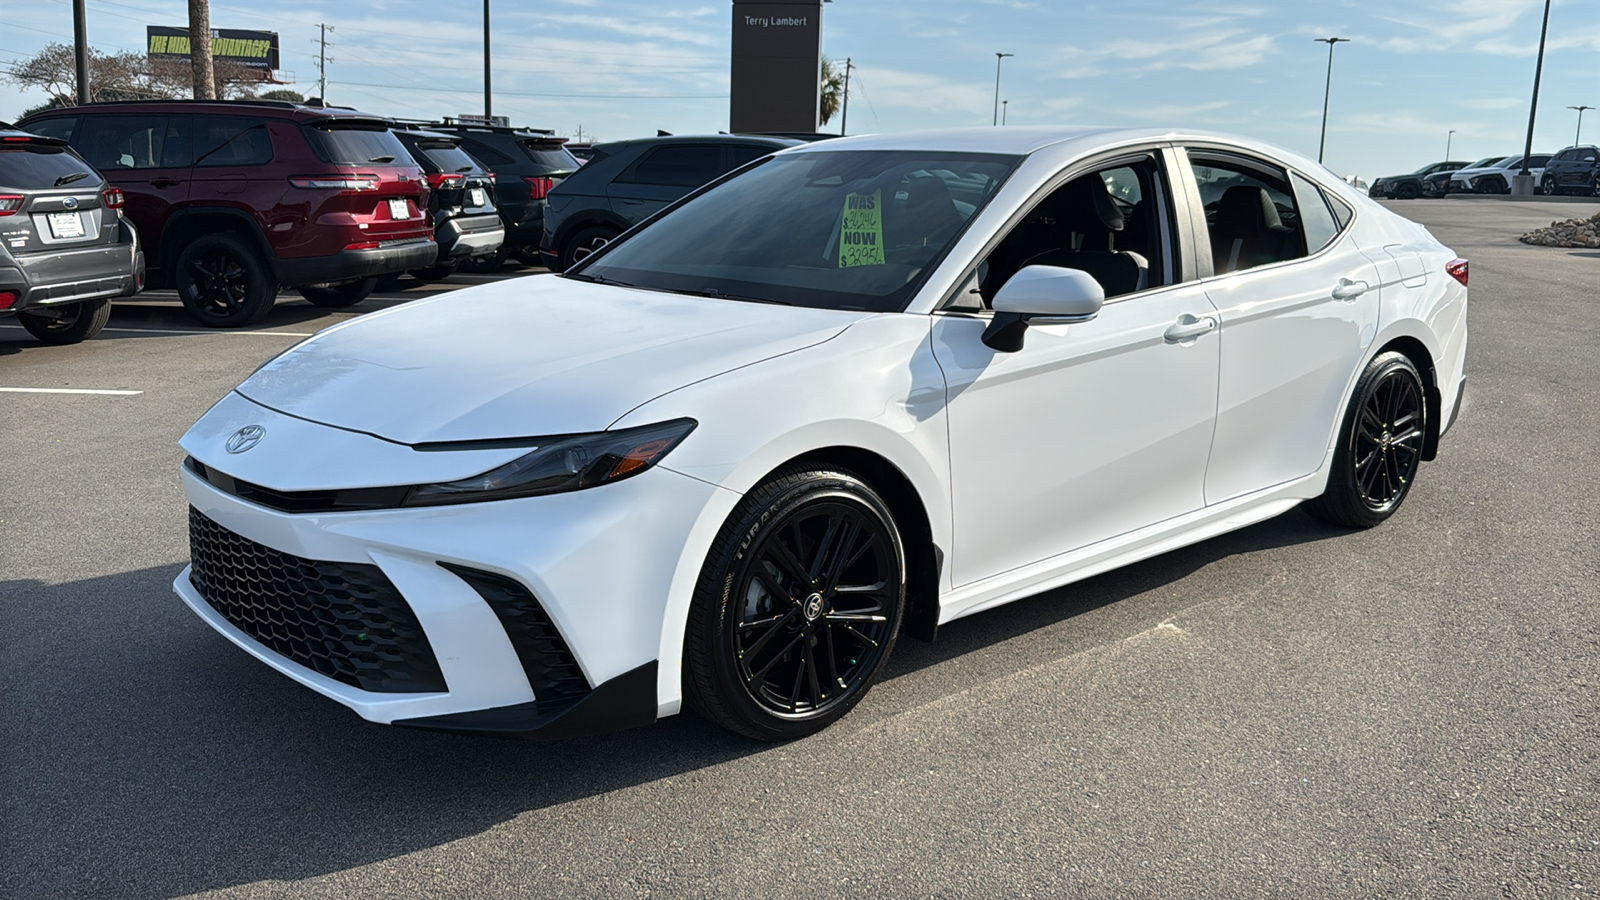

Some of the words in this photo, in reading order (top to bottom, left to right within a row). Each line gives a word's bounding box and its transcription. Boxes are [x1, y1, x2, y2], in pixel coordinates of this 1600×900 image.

[744, 16, 769, 28] Terry
[770, 16, 807, 26] Lambert
[149, 35, 168, 54] THE
[166, 36, 191, 55] MIRA
[848, 196, 875, 210] WAS
[844, 231, 876, 245] NOW
